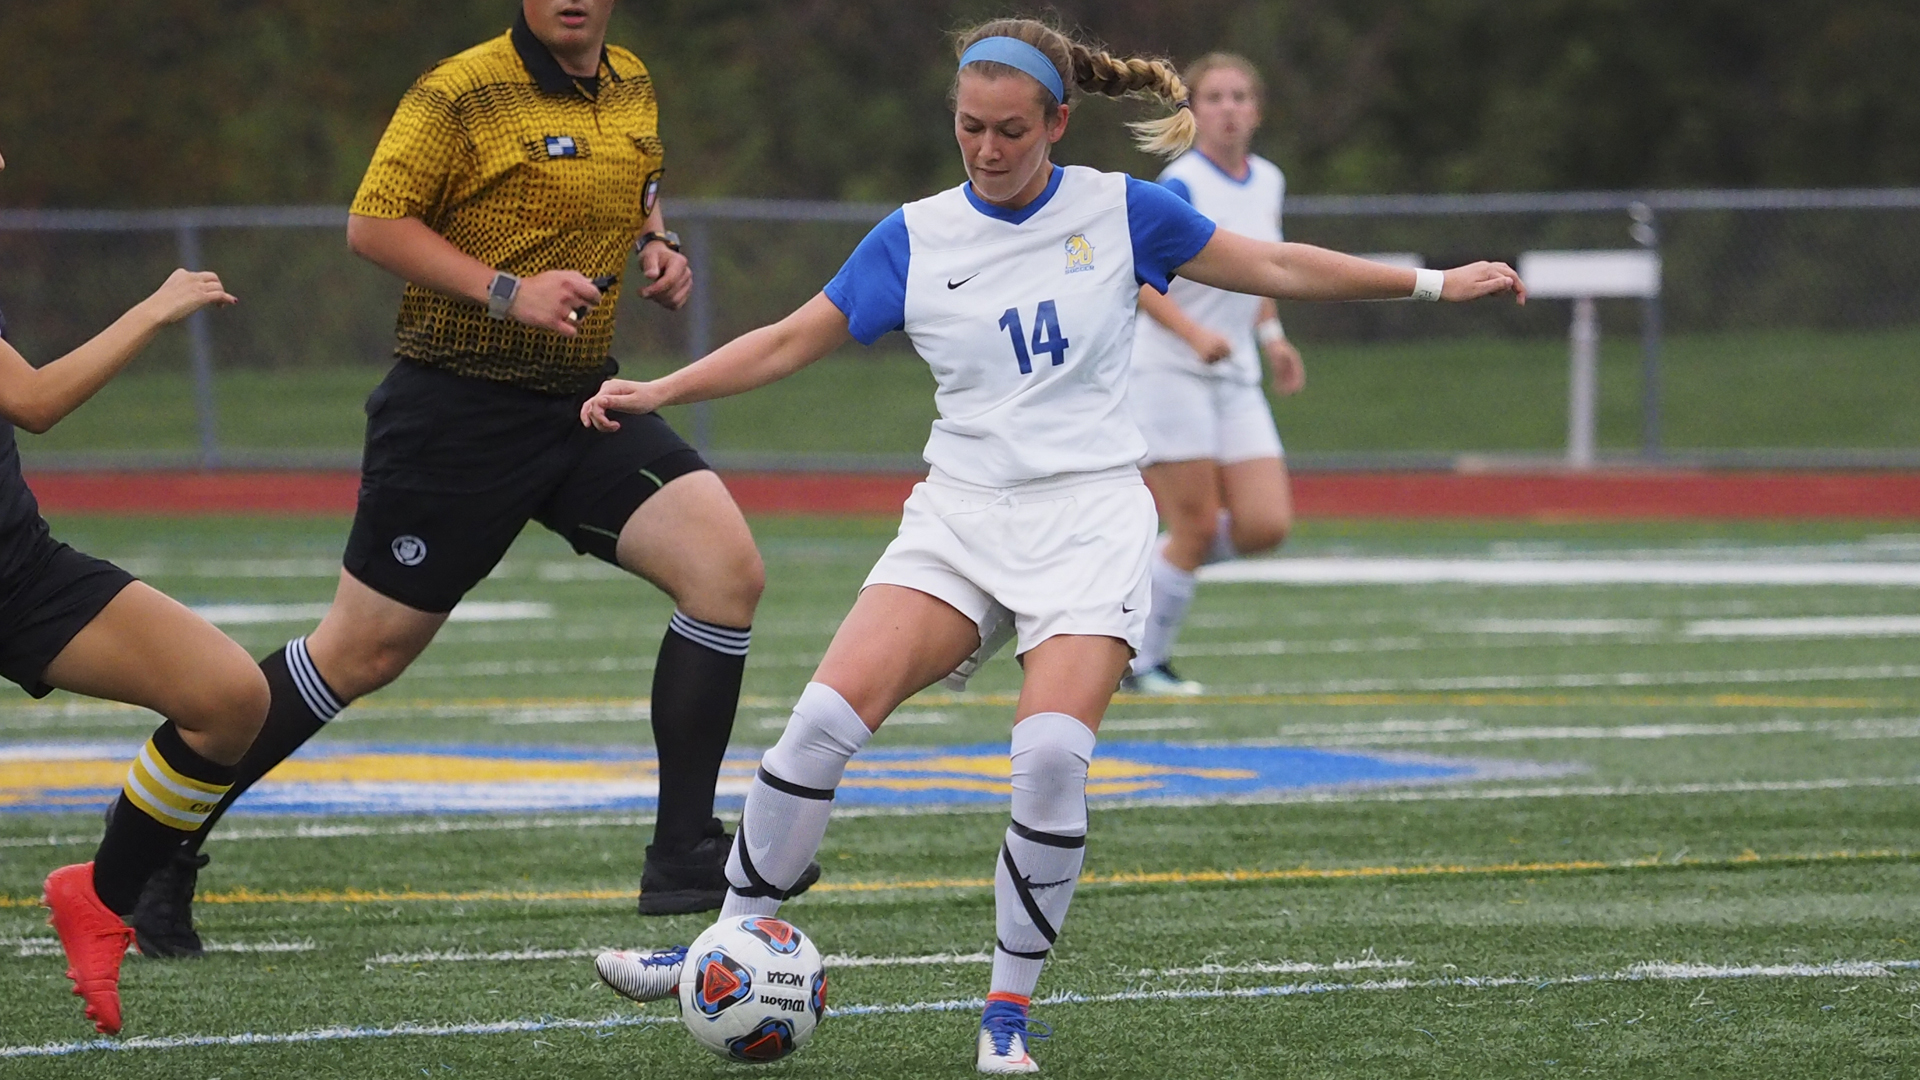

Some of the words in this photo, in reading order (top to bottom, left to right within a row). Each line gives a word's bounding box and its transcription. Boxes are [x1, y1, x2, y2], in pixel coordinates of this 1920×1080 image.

[1065, 246, 1096, 269] MU
[1064, 264, 1095, 275] SOCCER
[998, 299, 1070, 375] 14
[767, 970, 805, 987] NCAA
[760, 994, 805, 1012] Wilson
